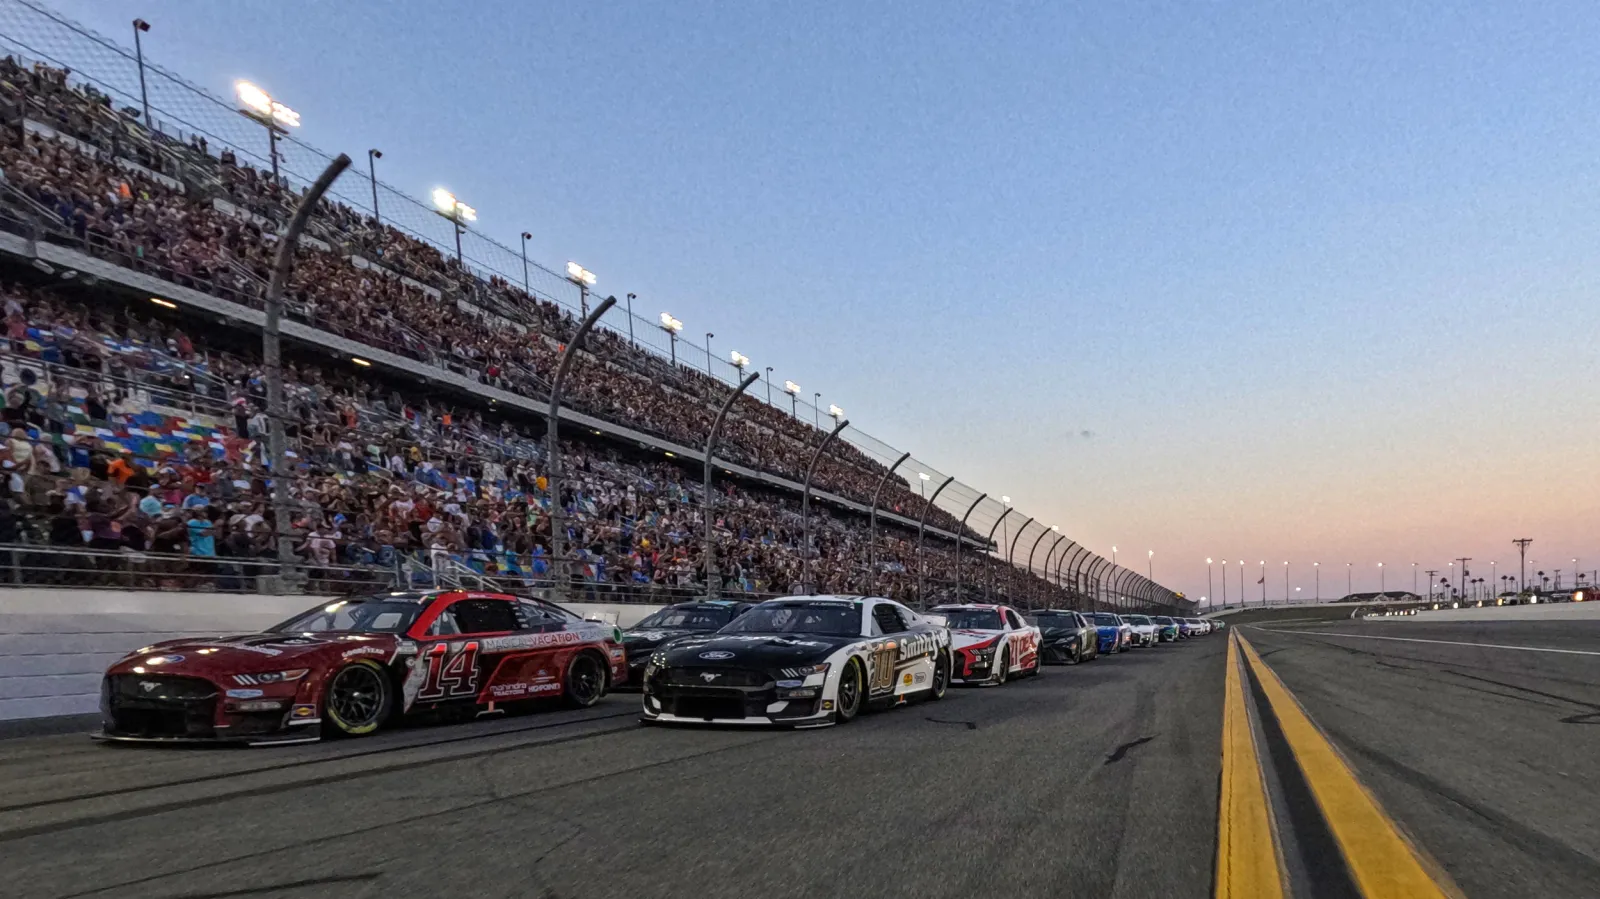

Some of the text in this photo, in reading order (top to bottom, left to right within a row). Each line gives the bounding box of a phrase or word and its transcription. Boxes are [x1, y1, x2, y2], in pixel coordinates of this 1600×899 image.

[531, 632, 580, 646] VACATION
[418, 641, 479, 699] 14
[870, 639, 897, 695] 10
[490, 683, 527, 692] mahindra
